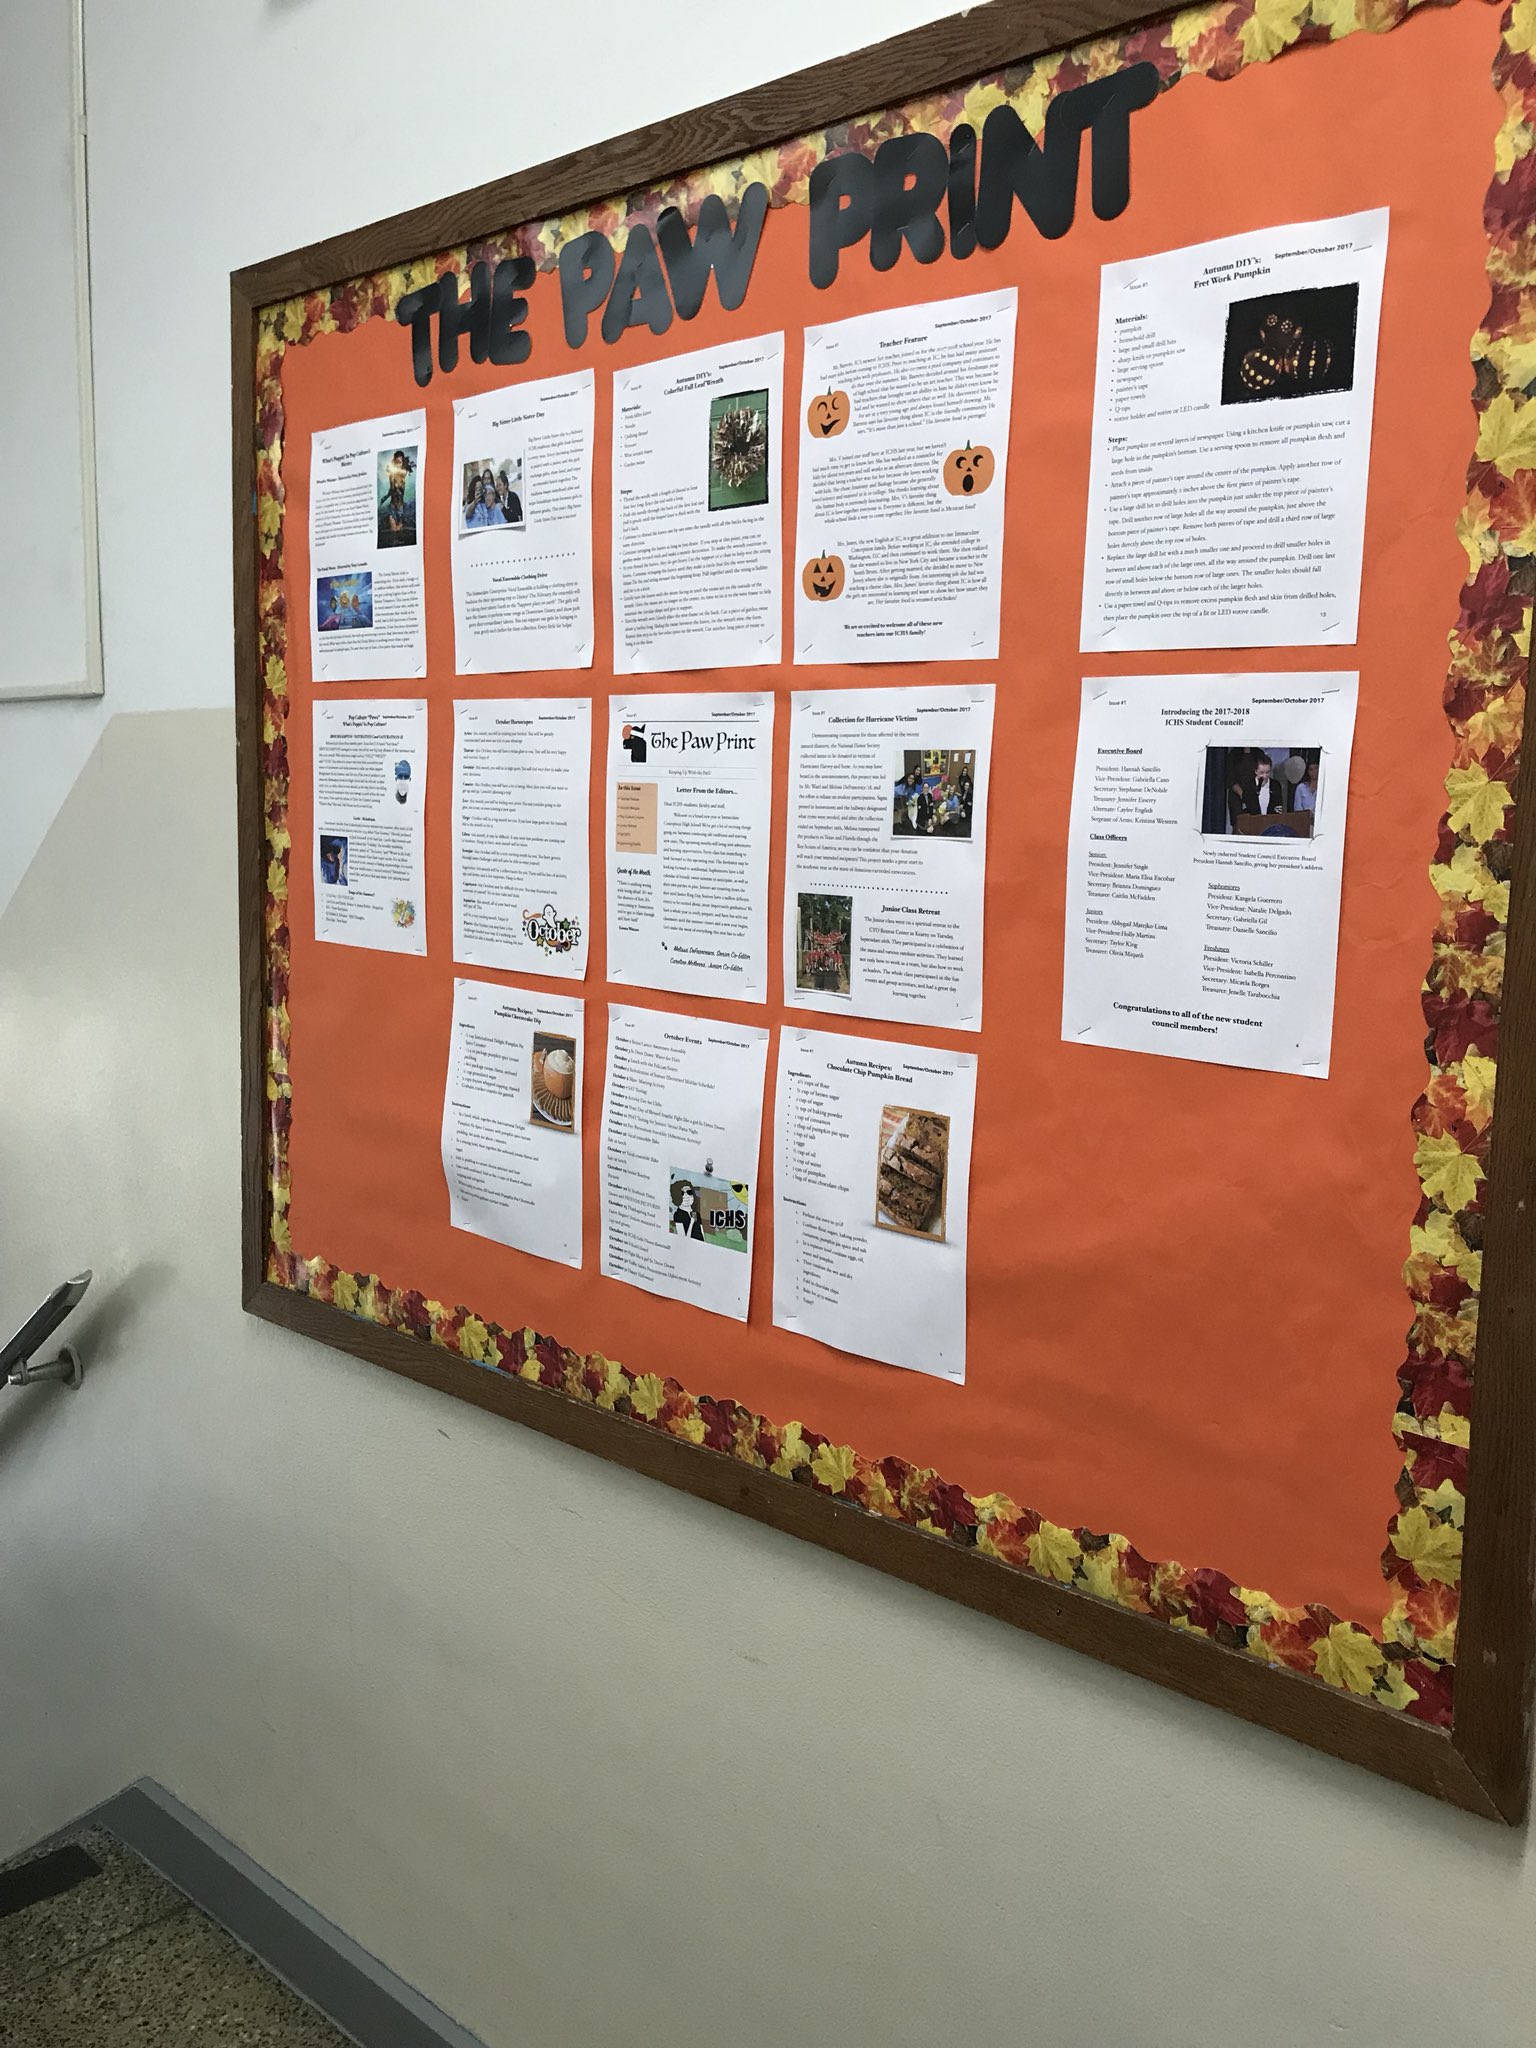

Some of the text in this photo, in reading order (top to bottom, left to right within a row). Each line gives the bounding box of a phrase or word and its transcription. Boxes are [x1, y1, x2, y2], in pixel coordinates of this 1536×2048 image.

[397, 61, 1160, 388] THE PAW PRINT
[1274, 242, 1353, 259] September/October 2017
[1202, 257, 1262, 275] Autumn DIY's:
[1193, 267, 1271, 289] Fret Work Pumpkin
[934, 314, 992, 329] September/October 2017
[1114, 314, 1148, 325] Materials:
[879, 336, 928, 349] Teacher Feature
[1107, 436, 1128, 445] Steps:
[1161, 707, 1251, 717] Introducing the 2017-2018
[827, 716, 856, 724] Collection
[855, 715, 866, 723] for
[865, 715, 895, 723] Hurricane
[1165, 718, 1244, 726] ICHS Student Council!
[650, 730, 757, 755] The Paw Print
[1097, 747, 1143, 755] Executive Board
[714, 787, 738, 795] Editors...
[1089, 833, 1128, 842] Class Officers
[880, 905, 941, 916] Junior Class Retreat
[1206, 903, 1292, 916] Vice-President: Natalie Delgado
[1205, 913, 1232, 923] Secretary:
[1232, 915, 1258, 924] Gabriella
[527, 918, 582, 946] October
[1203, 954, 1274, 968] President: Victoria Schiller
[1201, 975, 1270, 990] Secretary: Micaela Borges
[1112, 1002, 1172, 1016] Congratulations
[1180, 1010, 1191, 1019] all
[1191, 1011, 1202, 1020] of
[1201, 1012, 1215, 1021] the
[1232, 1018, 1263, 1027] student
[1151, 1020, 1218, 1034] council members!
[663, 1032, 703, 1045] October Events
[845, 1058, 893, 1072] Autumn Recipes:
[902, 1064, 942, 1075] September/October
[826, 1063, 913, 1084] Chocolate Chip Pumpkin Bread
[709, 1209, 747, 1230] ICHS
